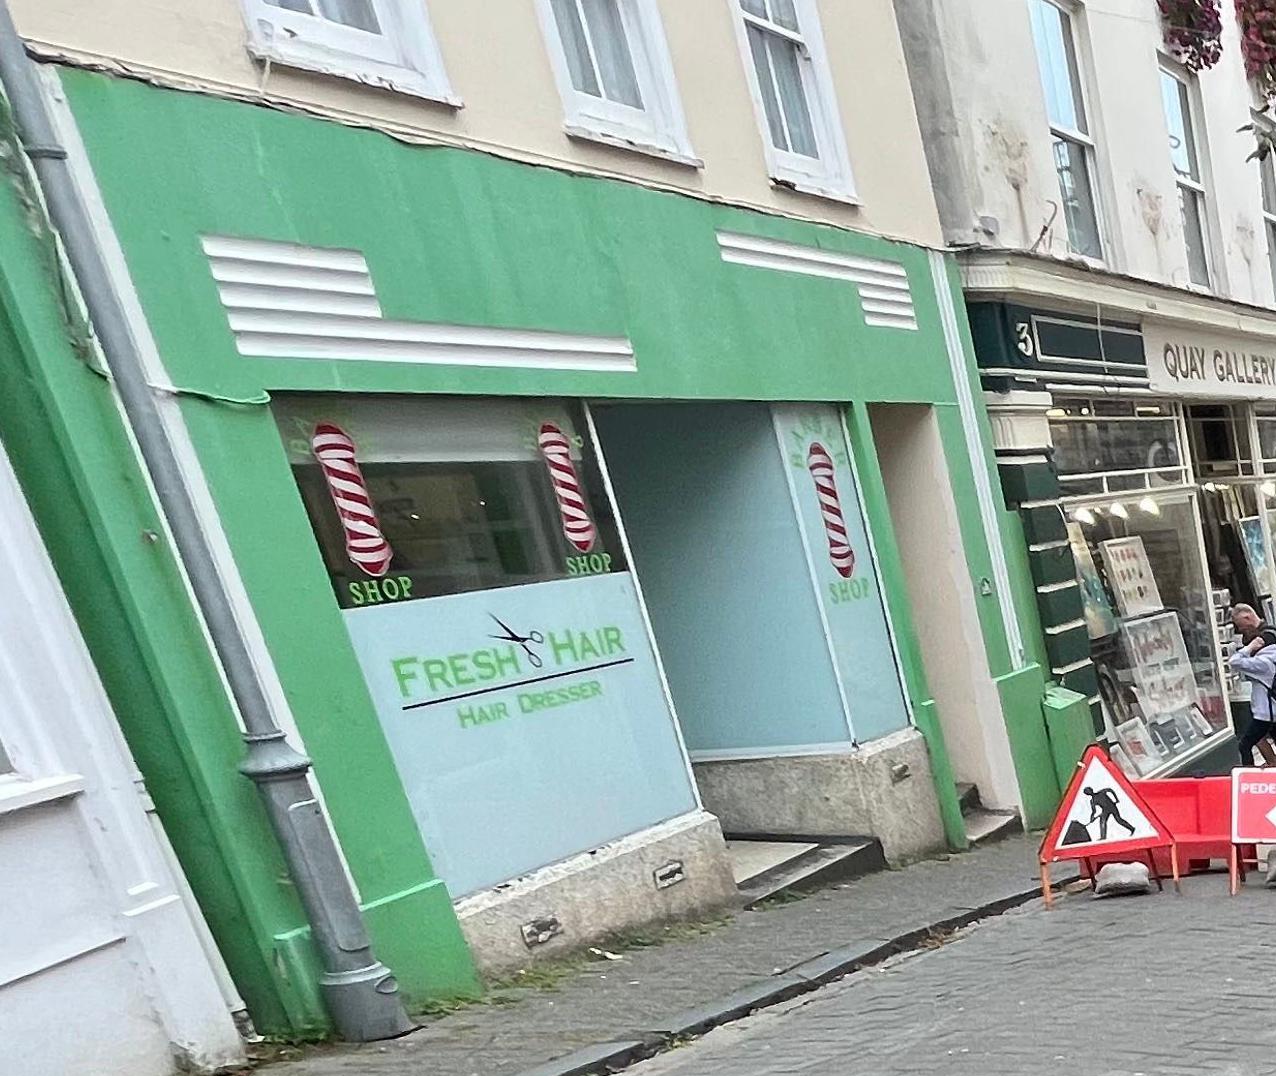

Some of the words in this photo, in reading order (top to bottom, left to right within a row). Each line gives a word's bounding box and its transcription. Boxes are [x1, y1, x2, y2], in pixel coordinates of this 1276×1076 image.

[1015, 322, 1034, 356] 3
[1162, 341, 1208, 381] QUAY
[1213, 348, 1276, 385] GALLERY
[565, 553, 612, 577] SHOP
[349, 576, 413, 605] SHOP
[829, 577, 870, 604] SHOP
[391, 645, 521, 697] FRESH
[548, 626, 626, 666] HAIR
[456, 702, 511, 729] HAIR
[516, 680, 603, 714] DRESSER
